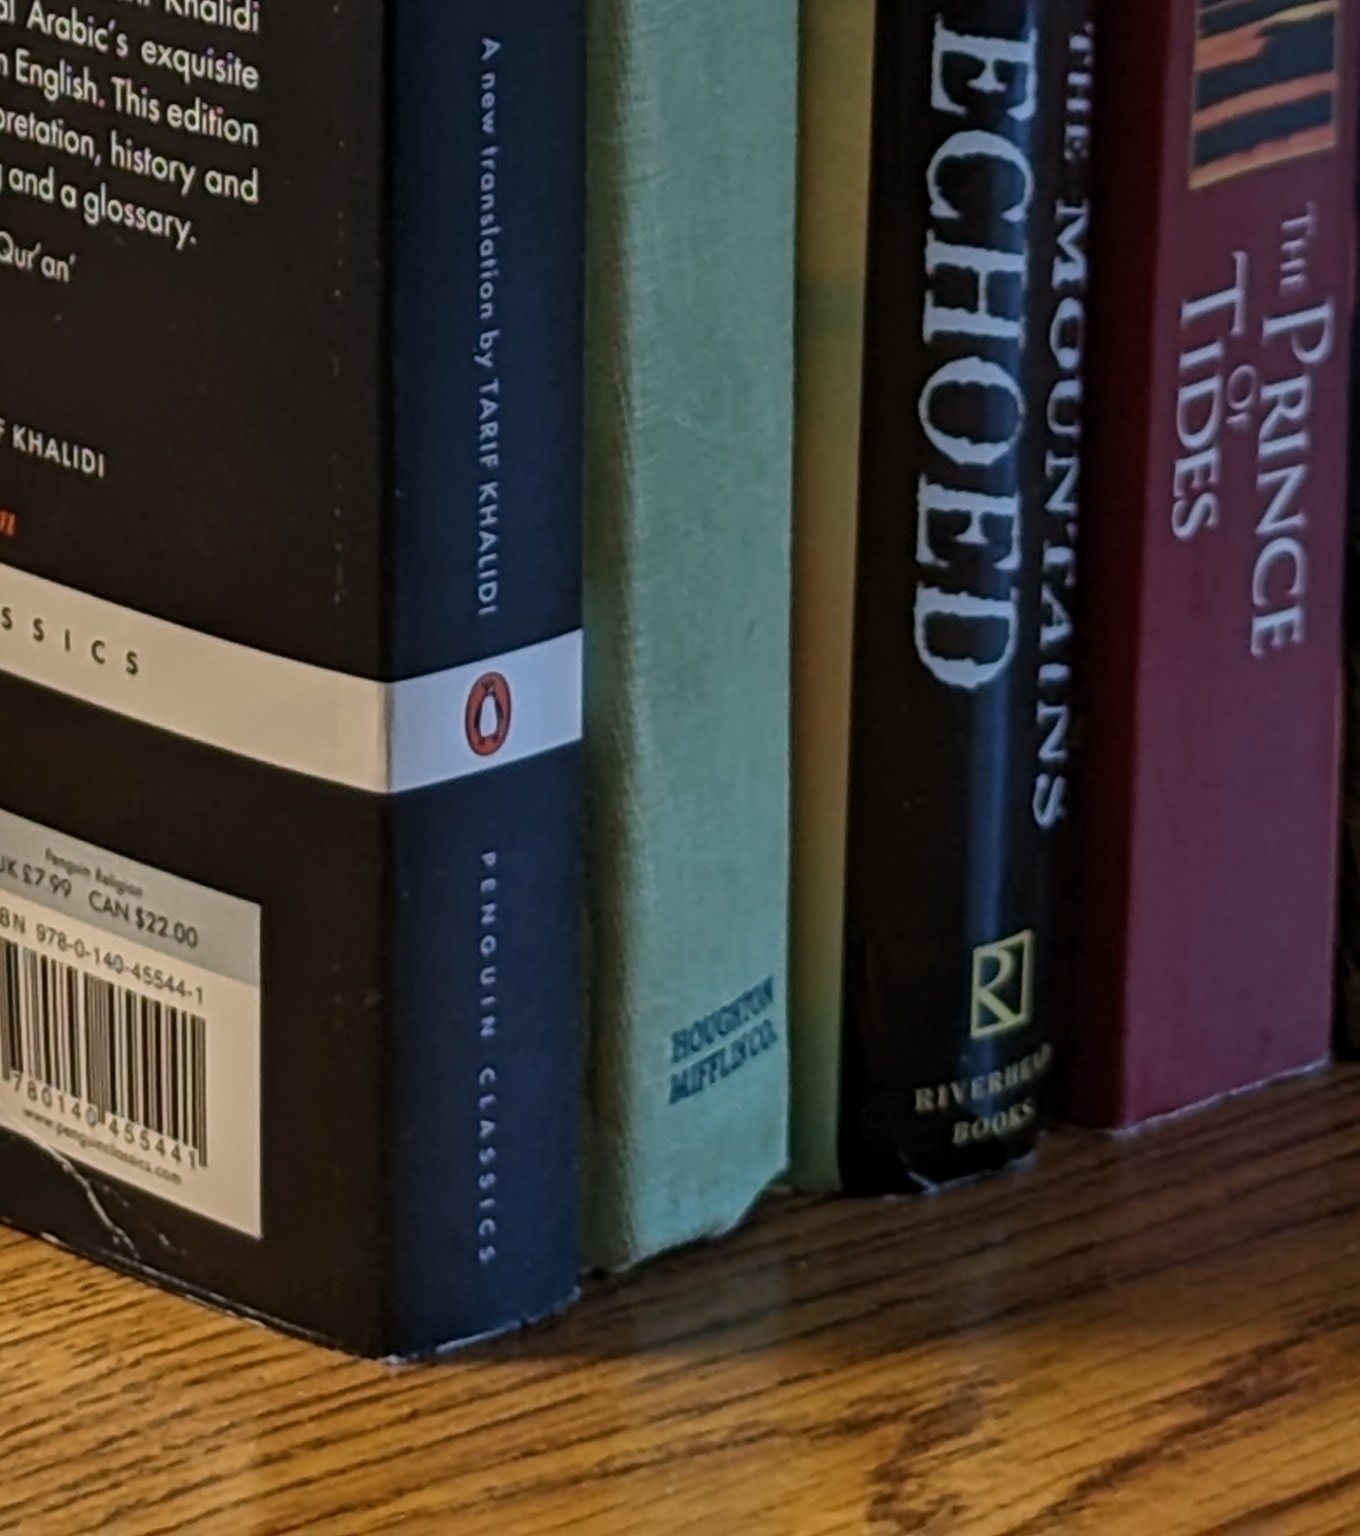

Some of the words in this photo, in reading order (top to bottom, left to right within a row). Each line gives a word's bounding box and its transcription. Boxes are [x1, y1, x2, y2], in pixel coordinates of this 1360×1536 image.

[15, 47, 105, 108] English.
[110, 76, 160, 122] This
[166, 96, 258, 146] edition
[141, 40, 259, 90] exquisite
[479, 37, 502, 61] A
[1064, 22, 1095, 164] THE
[479, 70, 496, 134] new
[8, 166, 54, 202] and
[60, 184, 77, 209] a
[83, 182, 196, 250] glossary.
[110, 130, 196, 196] history
[204, 167, 259, 203] and
[479, 144, 502, 321] translation
[1279, 201, 1316, 291] THE
[474, 328, 501, 369] by
[913, 12, 1039, 691] ECHOED
[1169, 249, 1250, 543] TIDES
[12, 424, 104, 478] KHALIDI
[478, 377, 500, 469] TARIF
[1031, 198, 1090, 831] MOUNTAINS
[1248, 297, 1335, 657] PRINCE
[477, 480, 500, 617] KHALIDI
[478, 850, 498, 1039] PENGUIN
[478, 1066, 497, 1263] CLASSICS
